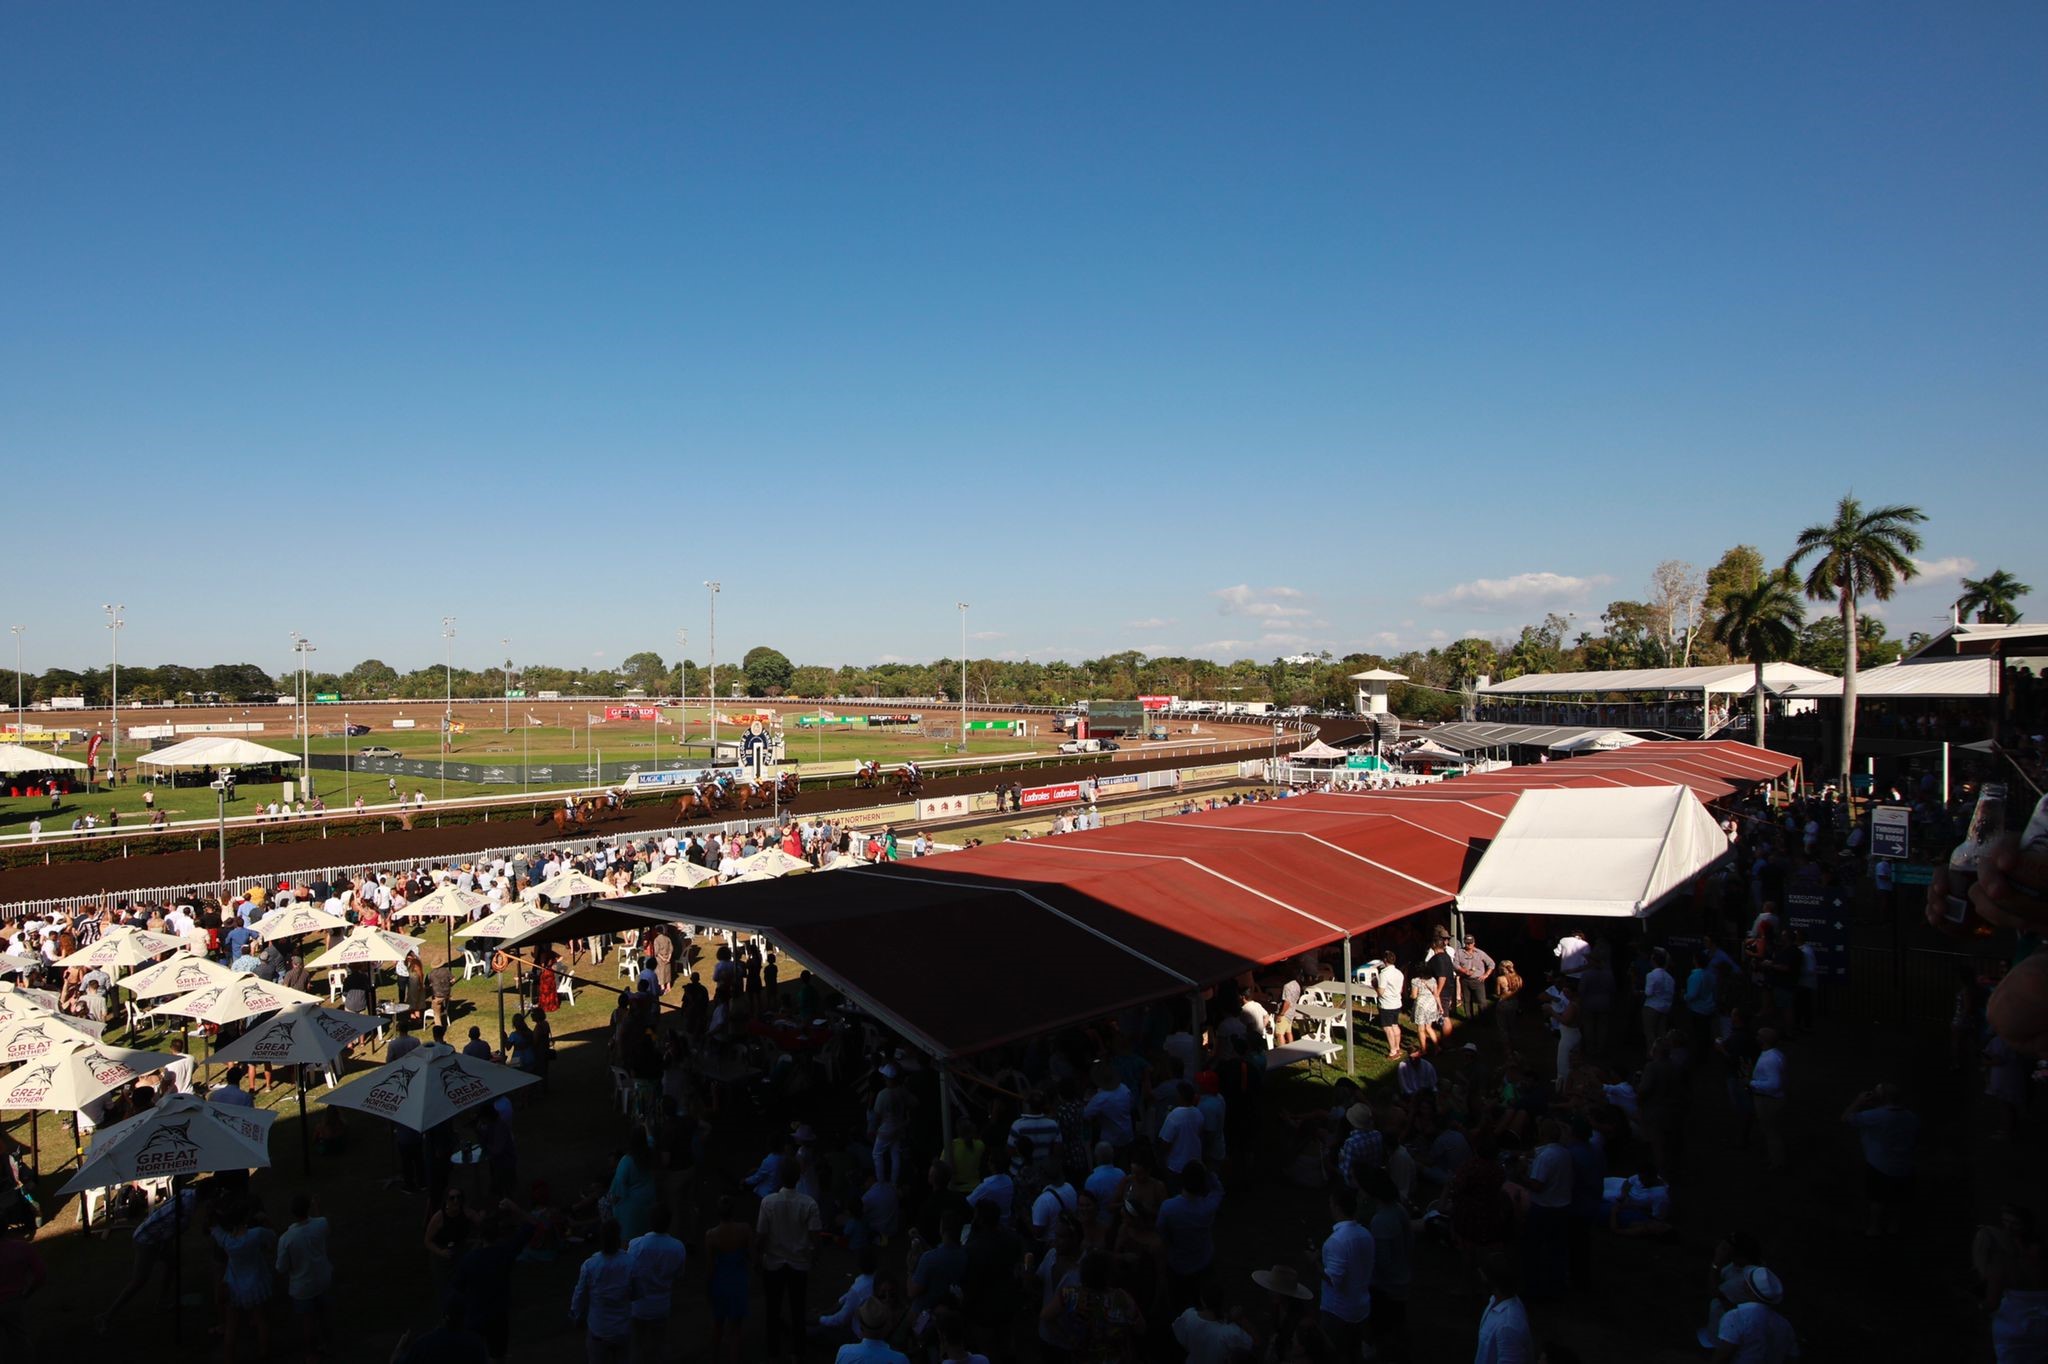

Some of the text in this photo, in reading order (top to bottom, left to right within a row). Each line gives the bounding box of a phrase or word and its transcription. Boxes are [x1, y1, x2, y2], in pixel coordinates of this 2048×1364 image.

[640, 775, 661, 783] MAGIC
[1024, 791, 1050, 803] Ladbrokes
[1054, 787, 1078, 799] Ladbrokes
[846, 812, 881, 824] NORTHERN
[176, 976, 209, 985] GREAT
[246, 996, 276, 1007] GREAT
[8, 1041, 53, 1053] GREAT
[255, 1042, 293, 1051] GREAT
[96, 1063, 129, 1081] GREAT
[11, 1087, 50, 1097] GREAT
[448, 1080, 484, 1099] GREAT
[452, 1085, 490, 1106] NORTHERN
[6, 1096, 45, 1104] NORTHERN
[370, 1088, 406, 1106] GREAT
[364, 1097, 400, 1112] NORTHERN
[138, 1149, 198, 1165] GREAT
[136, 1158, 198, 1172] NORTHERN
